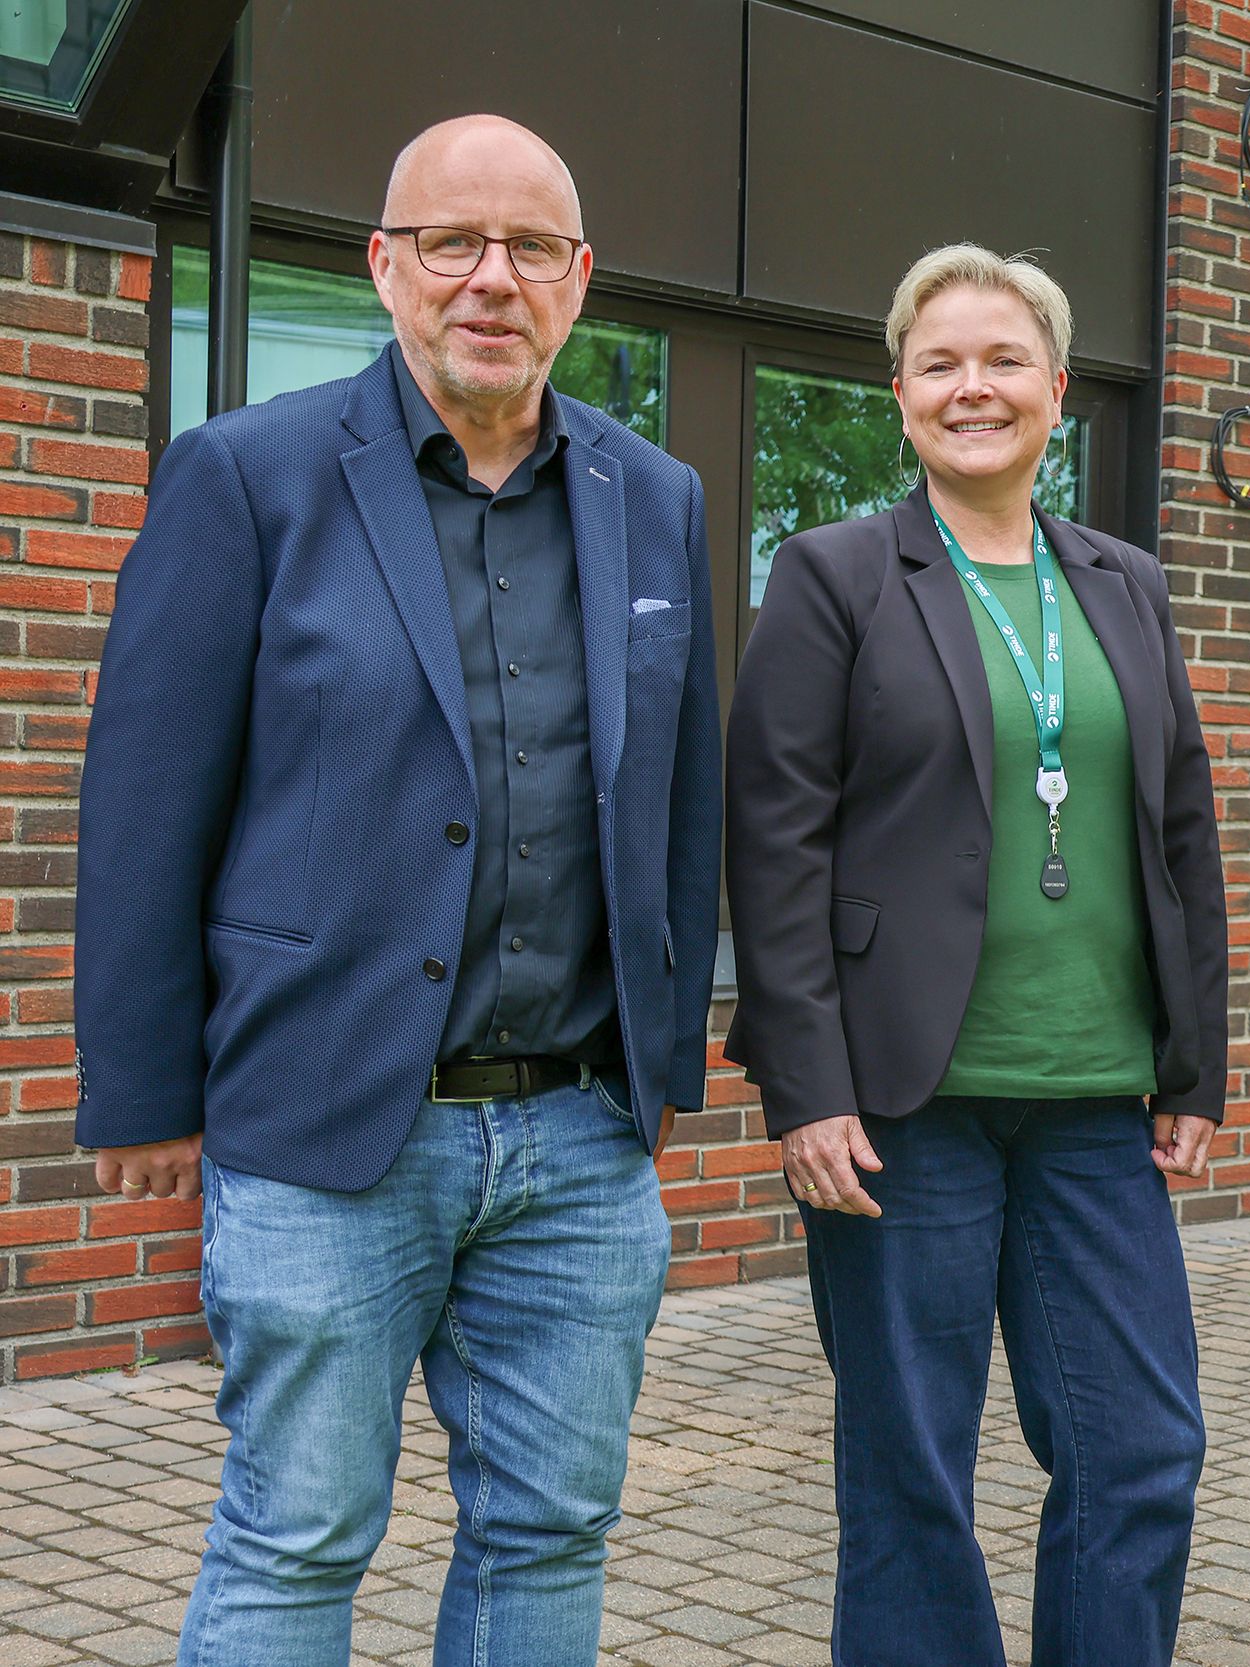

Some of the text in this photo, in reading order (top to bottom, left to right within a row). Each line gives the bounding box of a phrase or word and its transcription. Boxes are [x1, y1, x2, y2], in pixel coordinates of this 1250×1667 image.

[937, 526, 953, 547] TINDE
[973, 579, 991, 598] TINDE
[1009, 635, 1025, 657] TINDE
[1048, 631, 1056, 652] TINDE
[1048, 693, 1057, 716] TINDE
